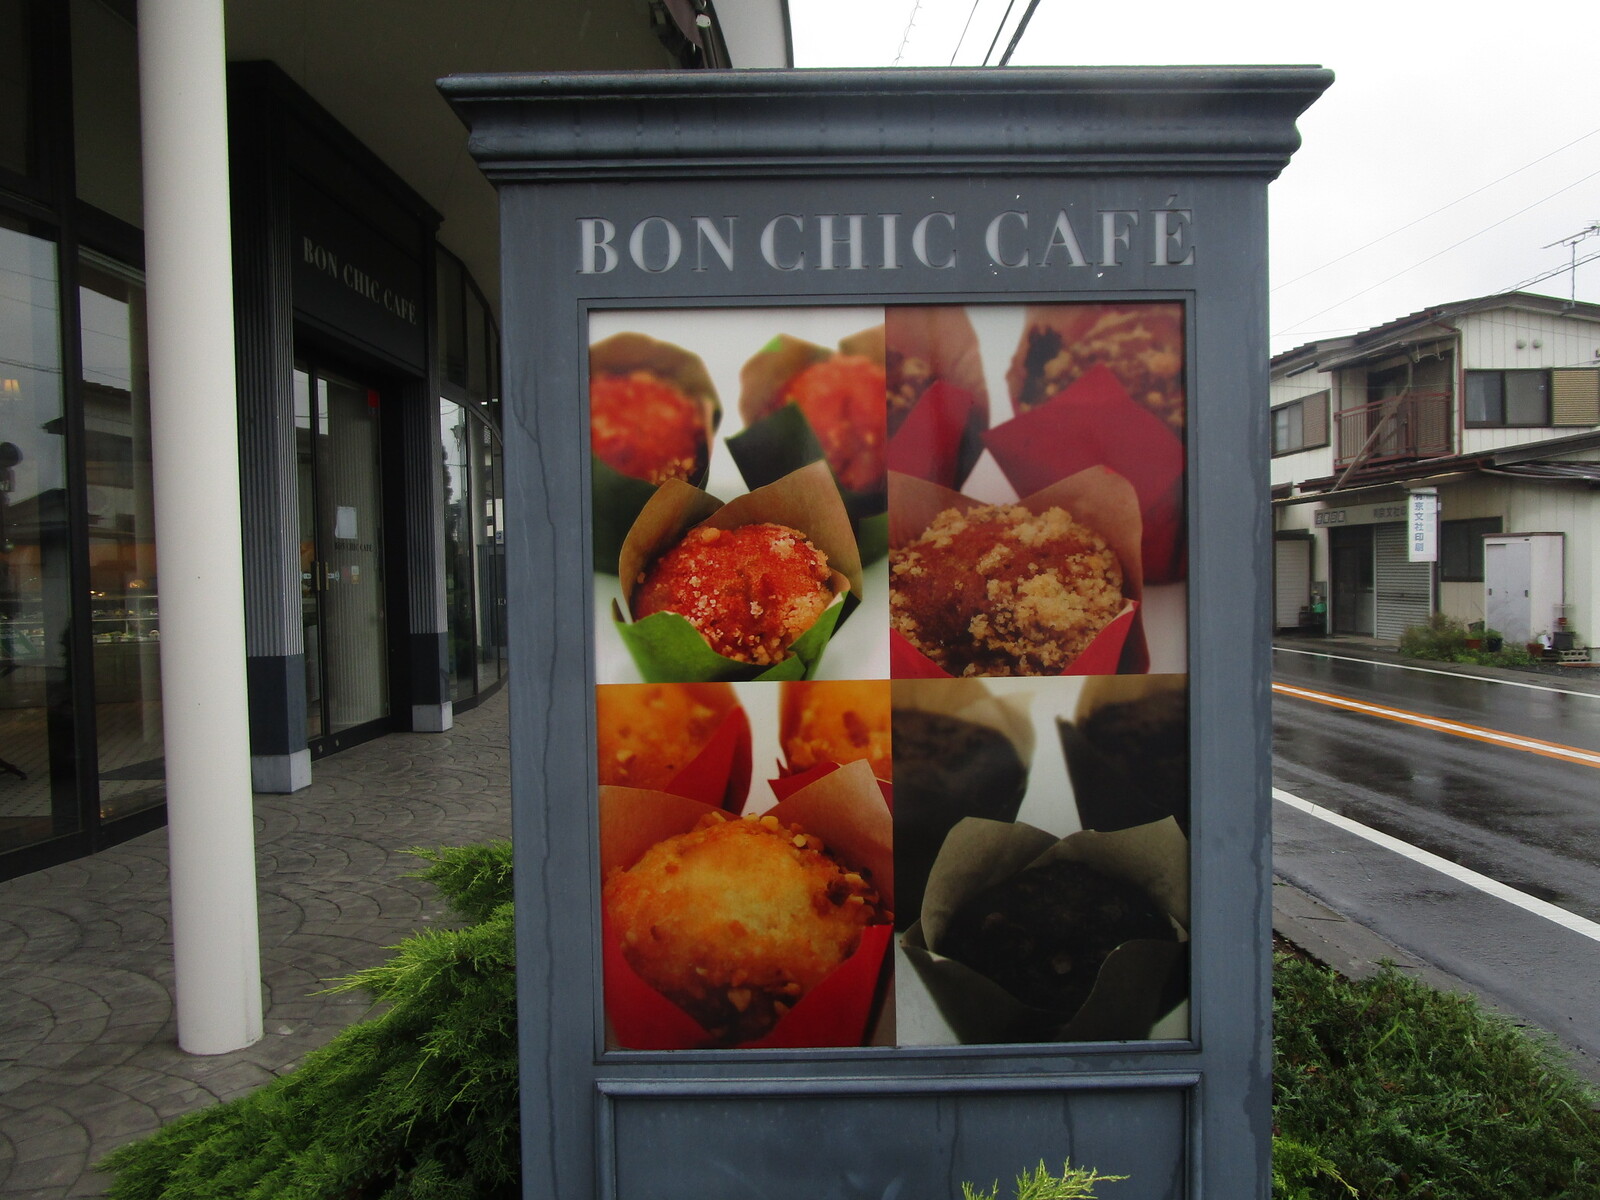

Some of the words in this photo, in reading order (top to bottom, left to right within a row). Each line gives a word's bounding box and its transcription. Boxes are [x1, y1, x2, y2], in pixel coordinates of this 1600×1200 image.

[303, 235, 338, 279] BON
[343, 263, 380, 304] CHIC
[575, 214, 739, 274] BON
[760, 210, 956, 271] CHIC
[985, 194, 1196, 268] CAFÉ
